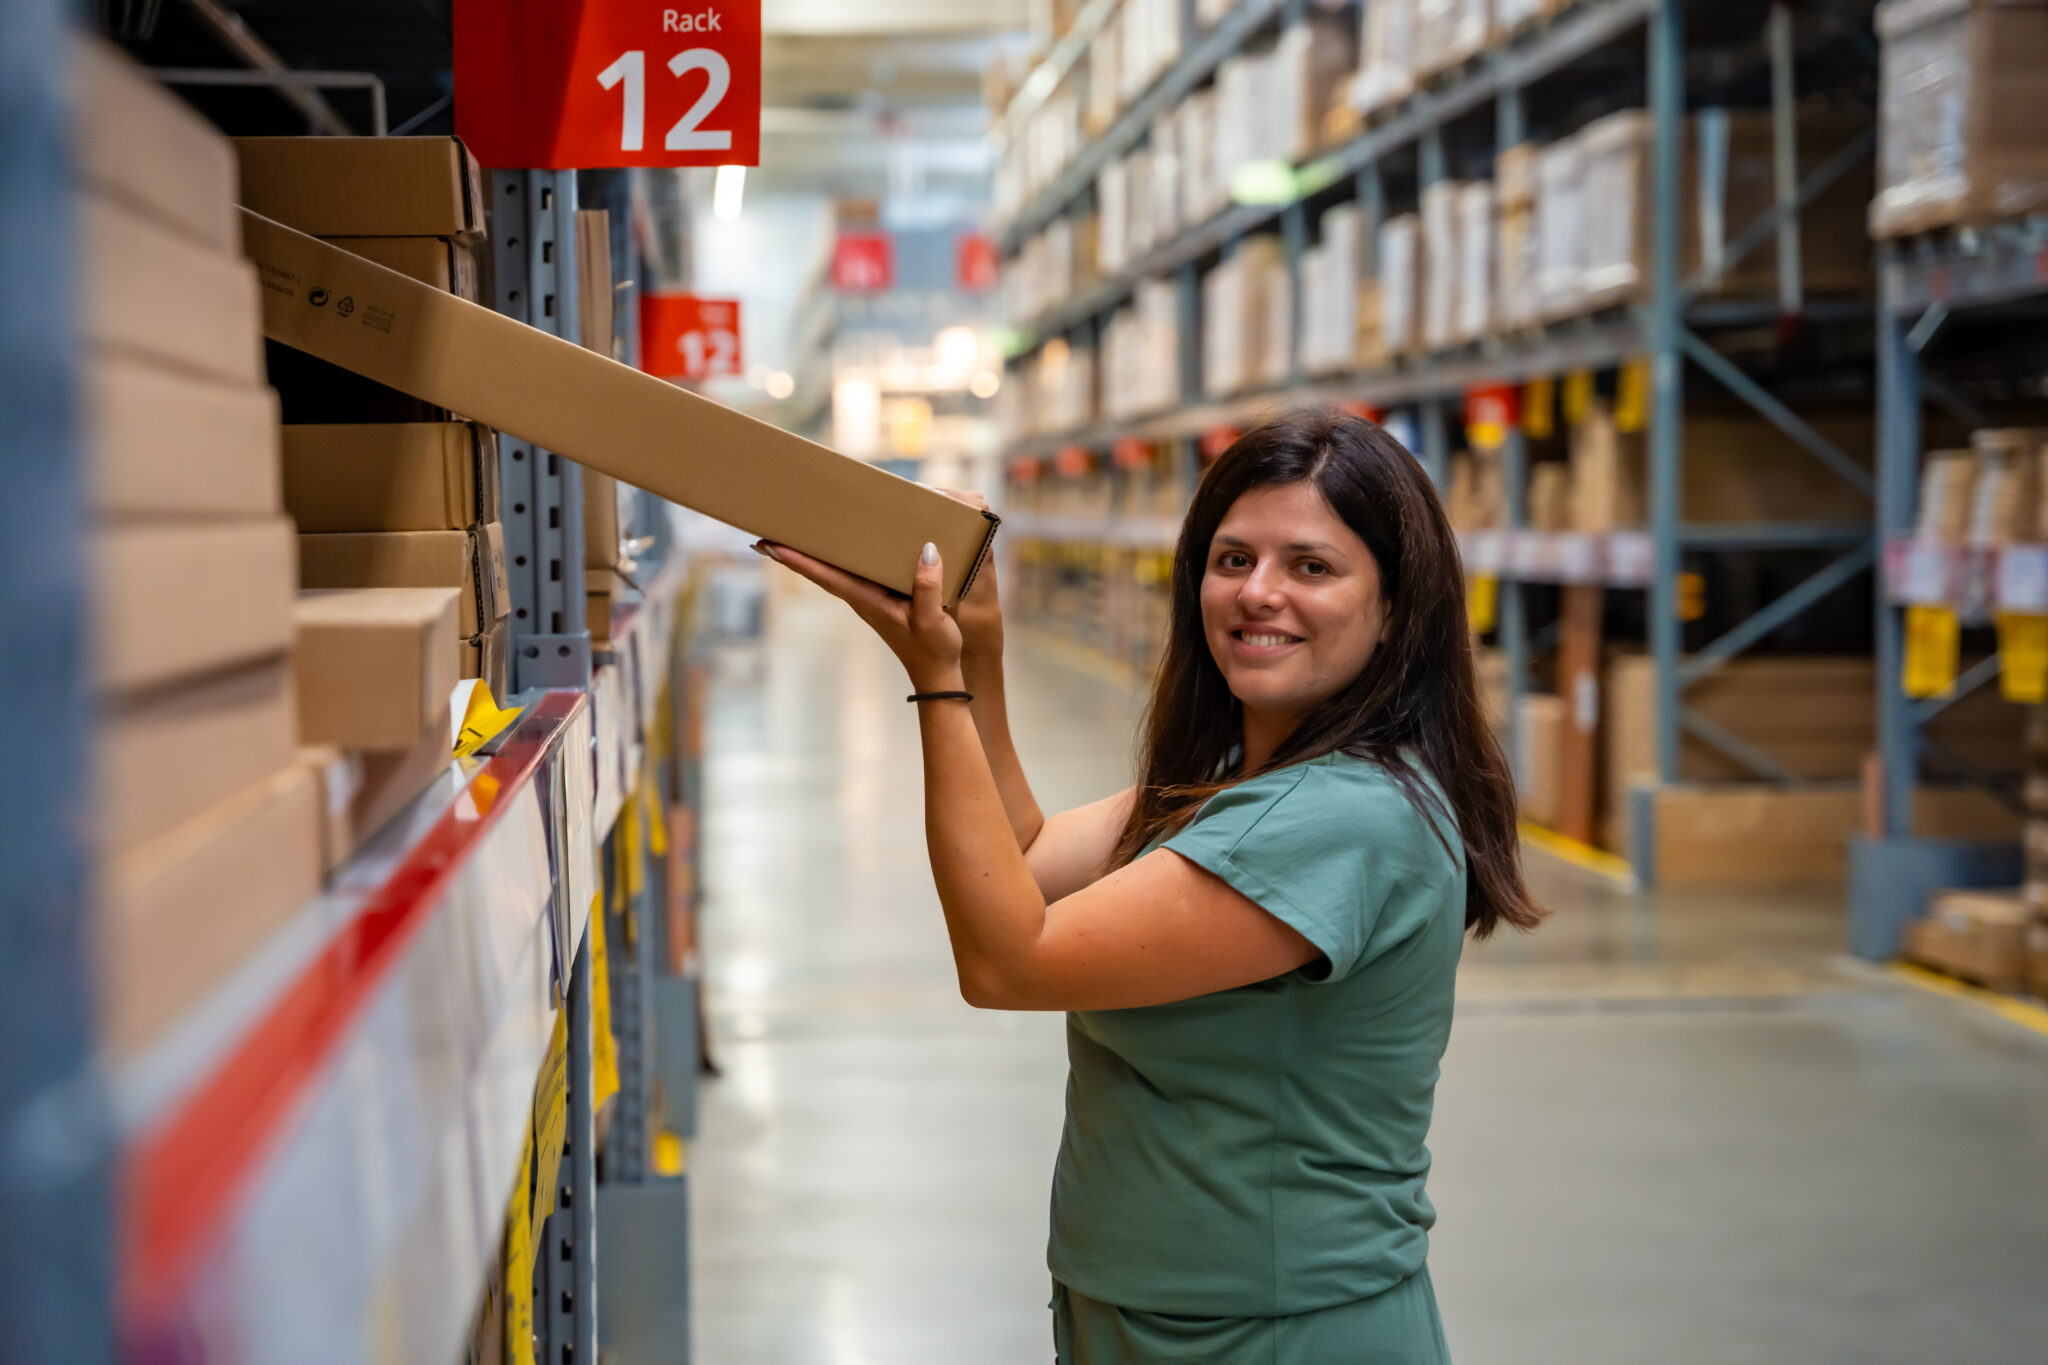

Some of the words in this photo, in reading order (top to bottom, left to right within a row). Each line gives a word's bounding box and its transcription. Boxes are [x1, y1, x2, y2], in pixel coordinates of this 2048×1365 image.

[663, 7, 722, 32] Rack
[597, 48, 732, 151] 12
[677, 331, 738, 378] 12
